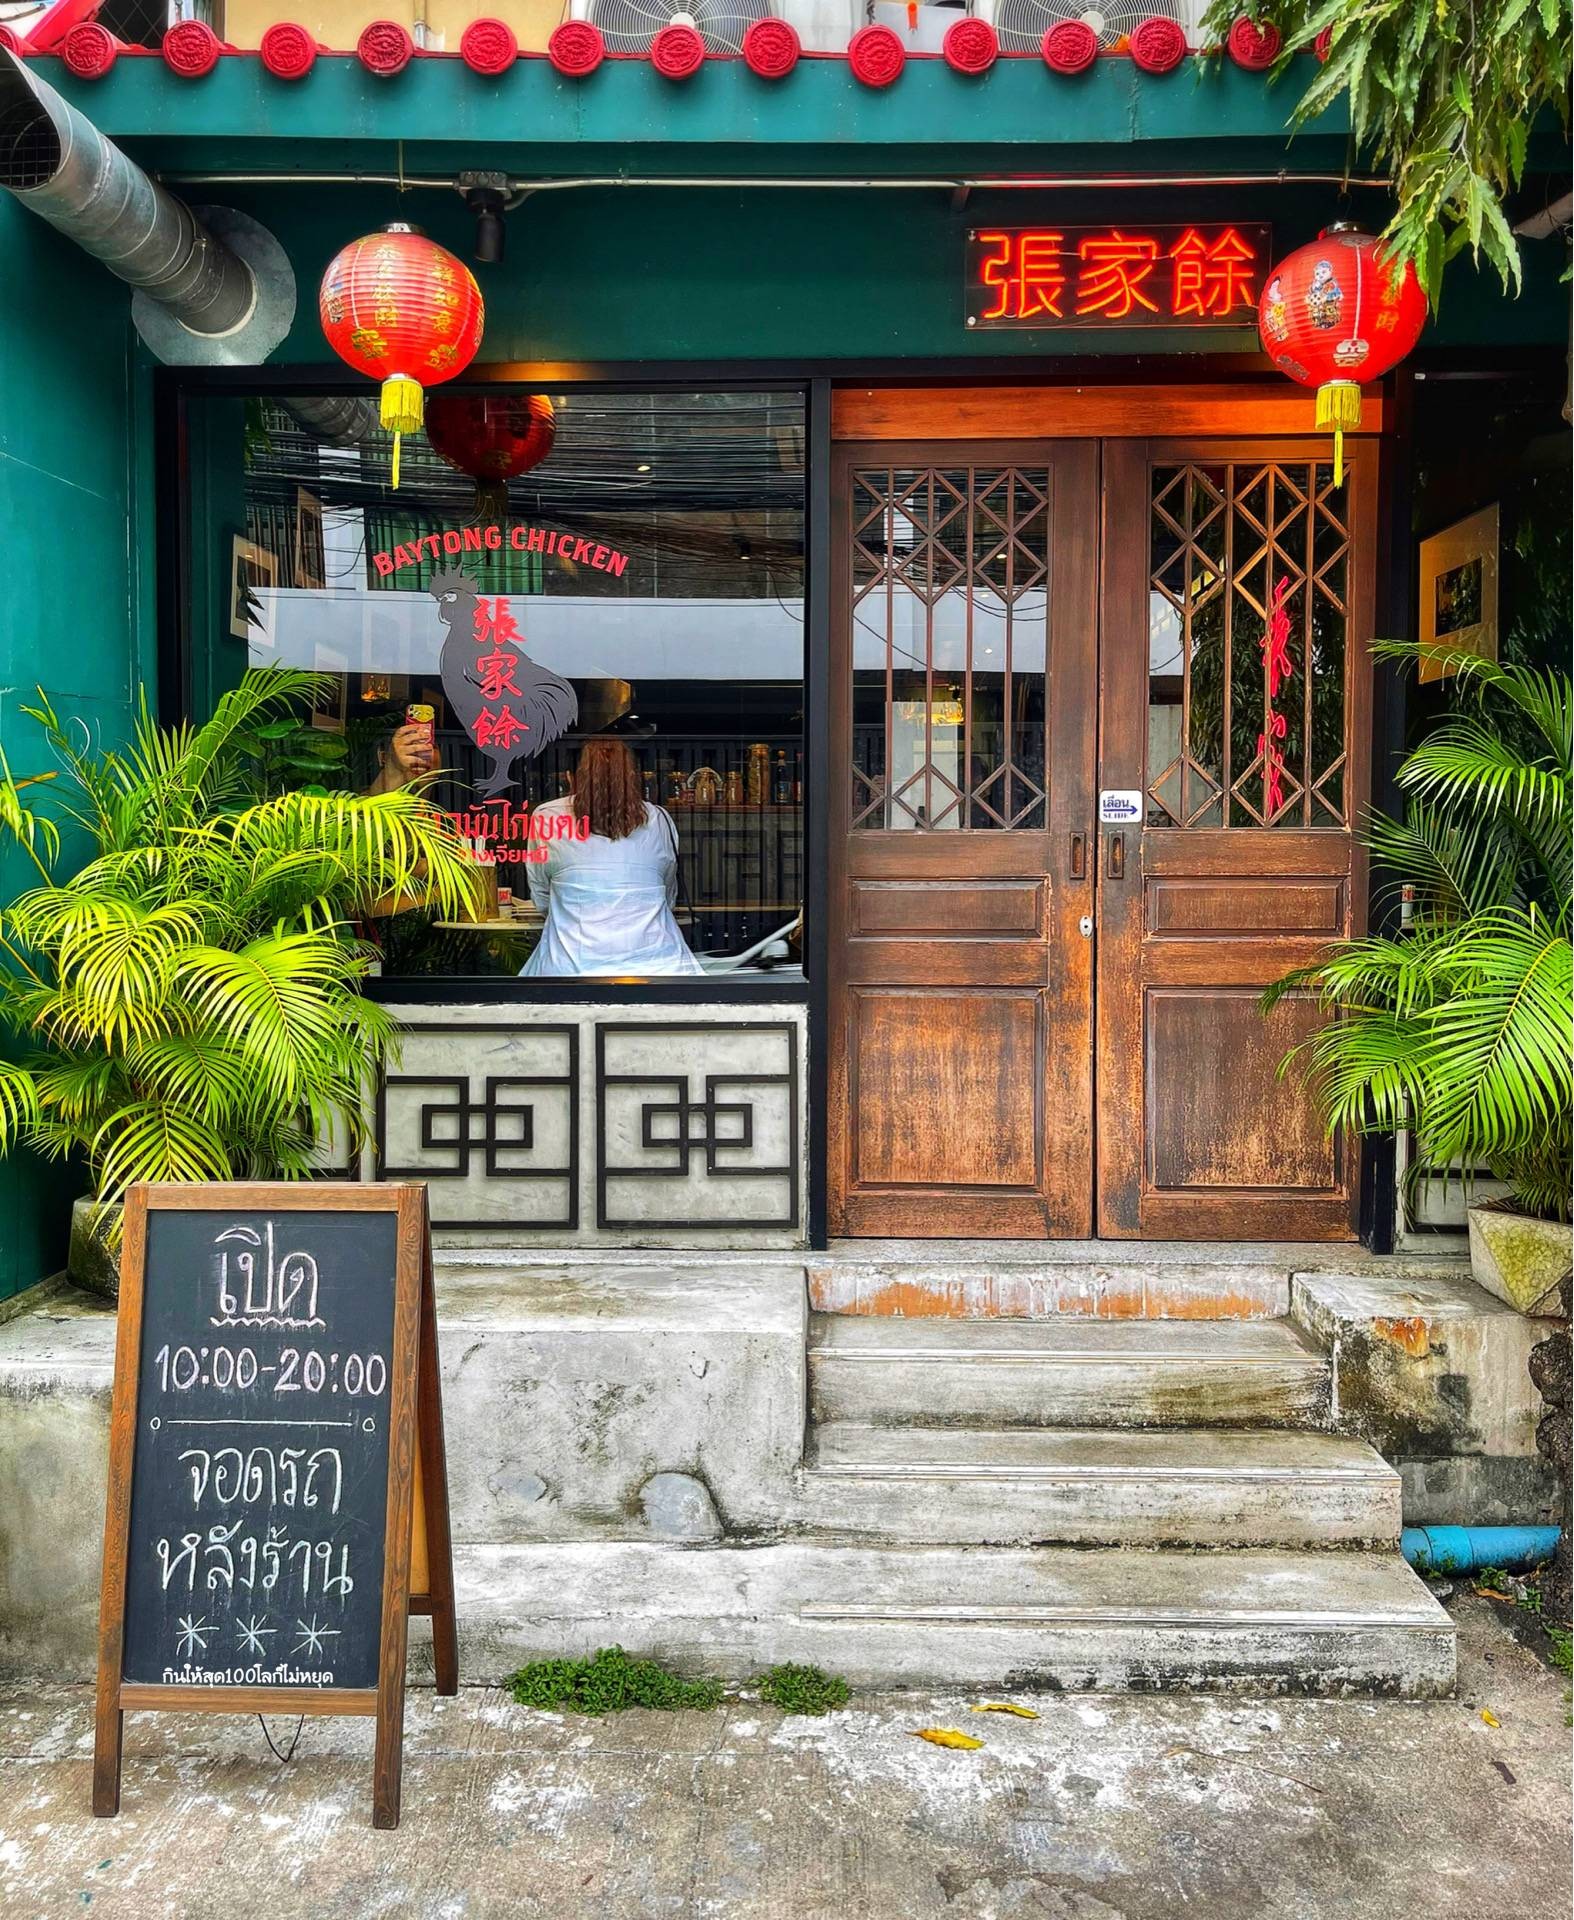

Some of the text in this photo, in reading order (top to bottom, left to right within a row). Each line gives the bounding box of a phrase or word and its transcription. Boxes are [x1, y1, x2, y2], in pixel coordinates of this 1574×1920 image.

[979, 229, 1254, 318] 張家餘
[372, 525, 629, 577] BAYTONG CHICKEN
[471, 596, 530, 751] 張家餘
[415, 798, 590, 843] าวมันไก่เบตง
[1102, 794, 1130, 808] เลื่อน
[214, 1220, 319, 1319] เปิด
[154, 1344, 387, 1396] 10:00-20:00
[177, 1447, 343, 1514] จอดรถ
[156, 1519, 354, 1594] หลังร้าน
